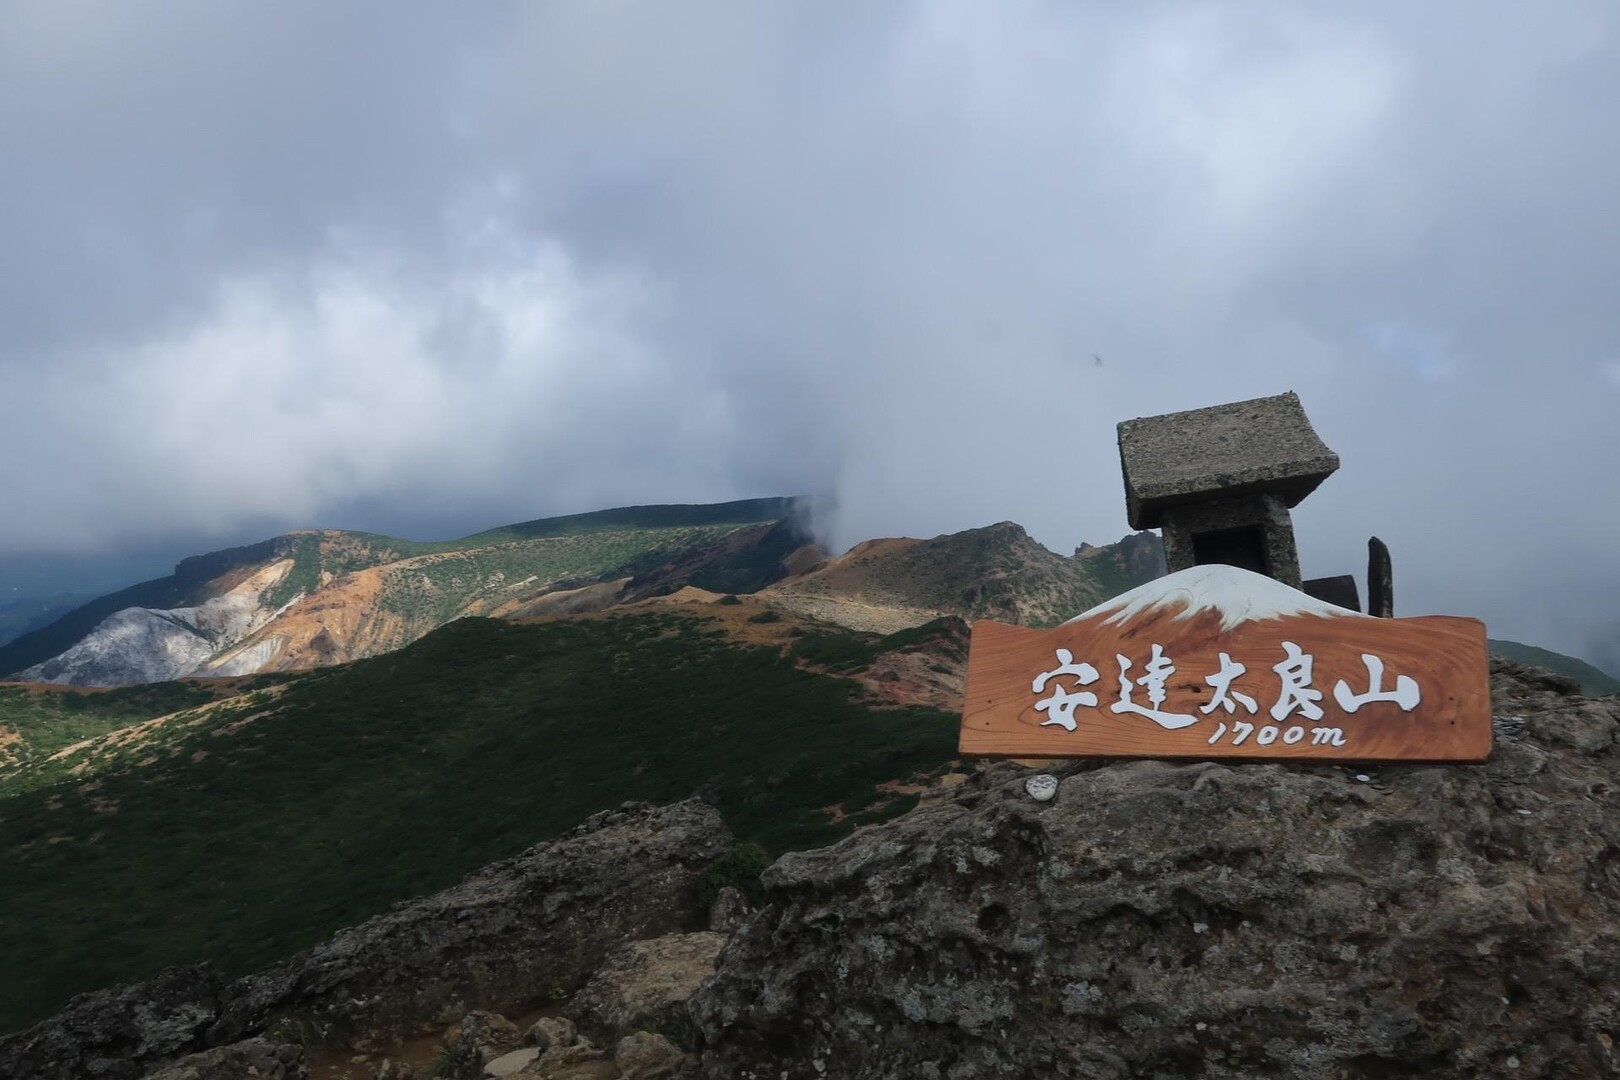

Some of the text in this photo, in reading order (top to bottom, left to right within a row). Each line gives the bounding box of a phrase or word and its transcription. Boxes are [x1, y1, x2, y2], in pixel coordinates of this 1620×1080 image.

[1033, 641, 1421, 731] 安達太良山
[1208, 721, 1347, 747] 1700m
